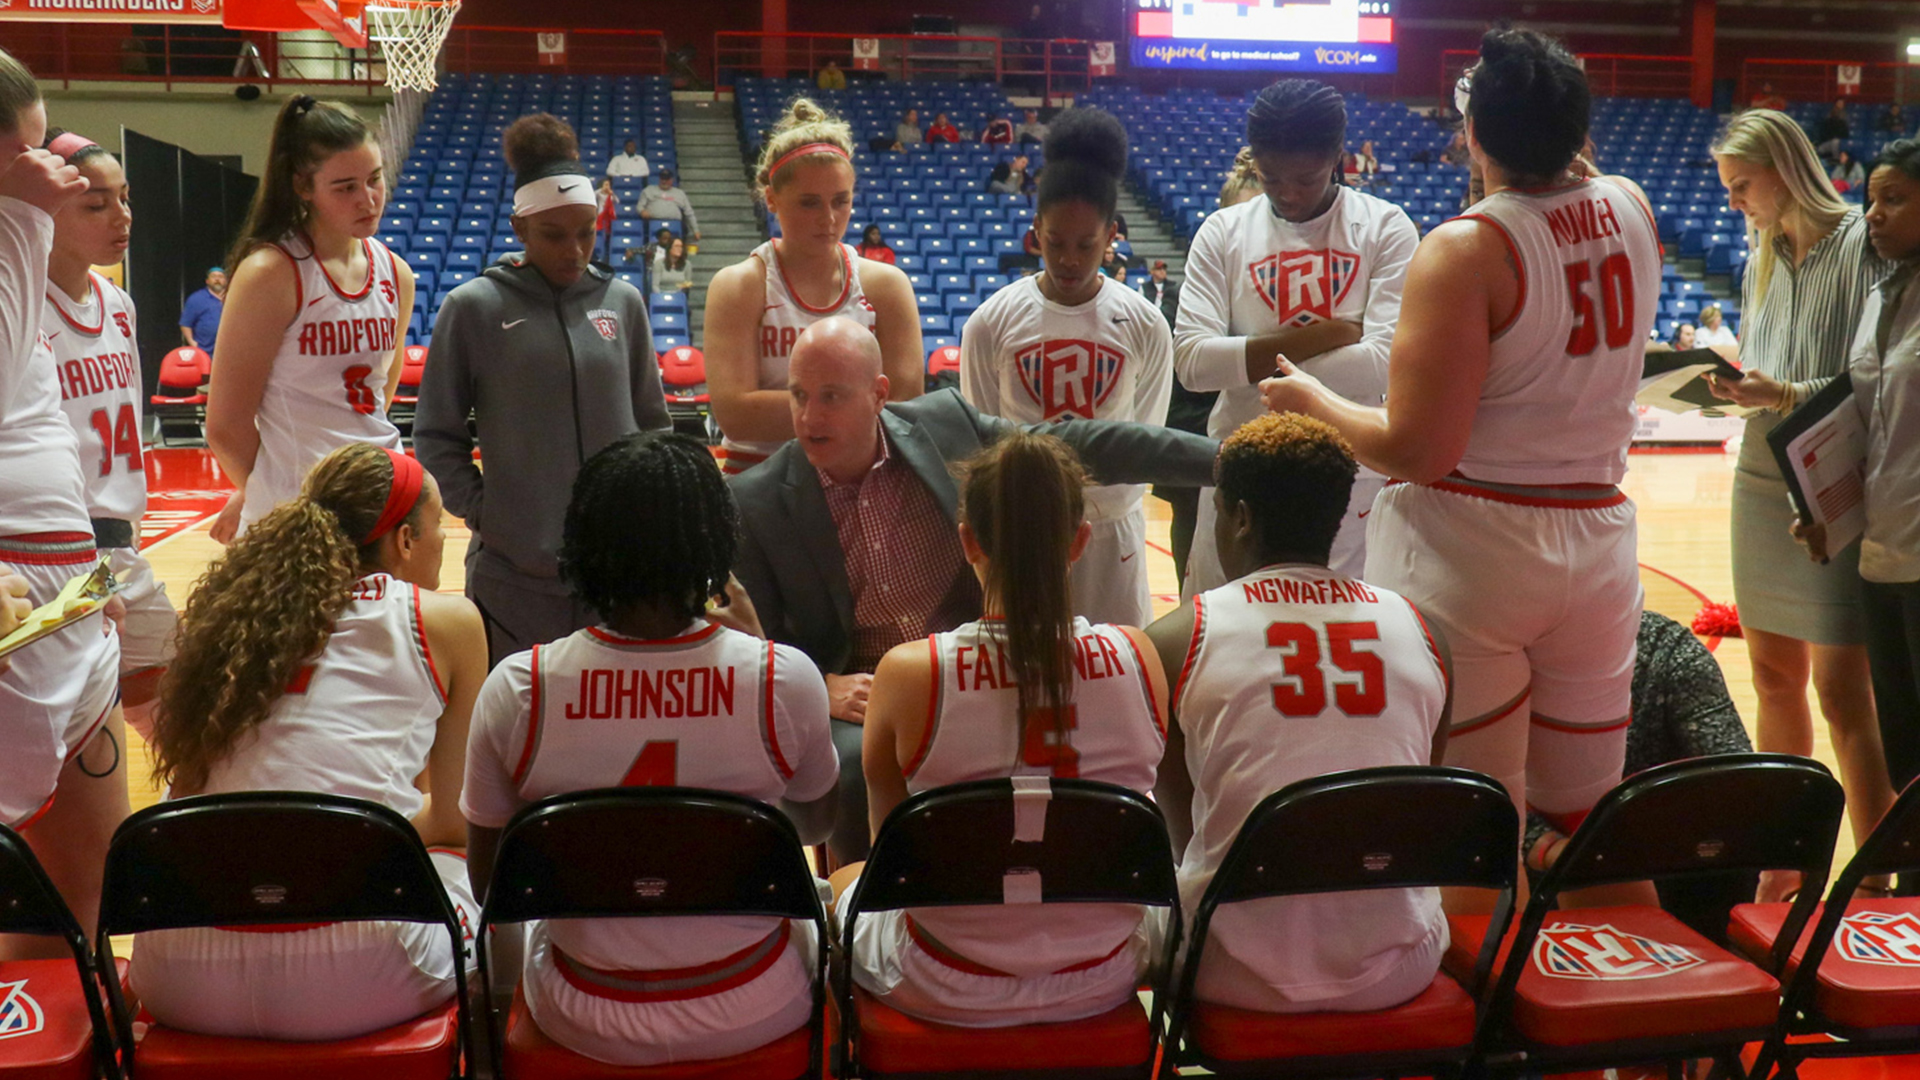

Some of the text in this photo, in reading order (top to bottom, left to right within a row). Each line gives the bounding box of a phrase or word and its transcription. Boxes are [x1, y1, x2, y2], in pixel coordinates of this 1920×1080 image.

[1145, 43, 1208, 64] inspired
[1563, 250, 1635, 359] 50
[89, 401, 144, 478] 14
[1242, 577, 1379, 604] NGWAFANG
[956, 633, 1126, 692] FALNER
[1263, 620, 1388, 719] 35
[565, 666, 735, 720] JOHNSON
